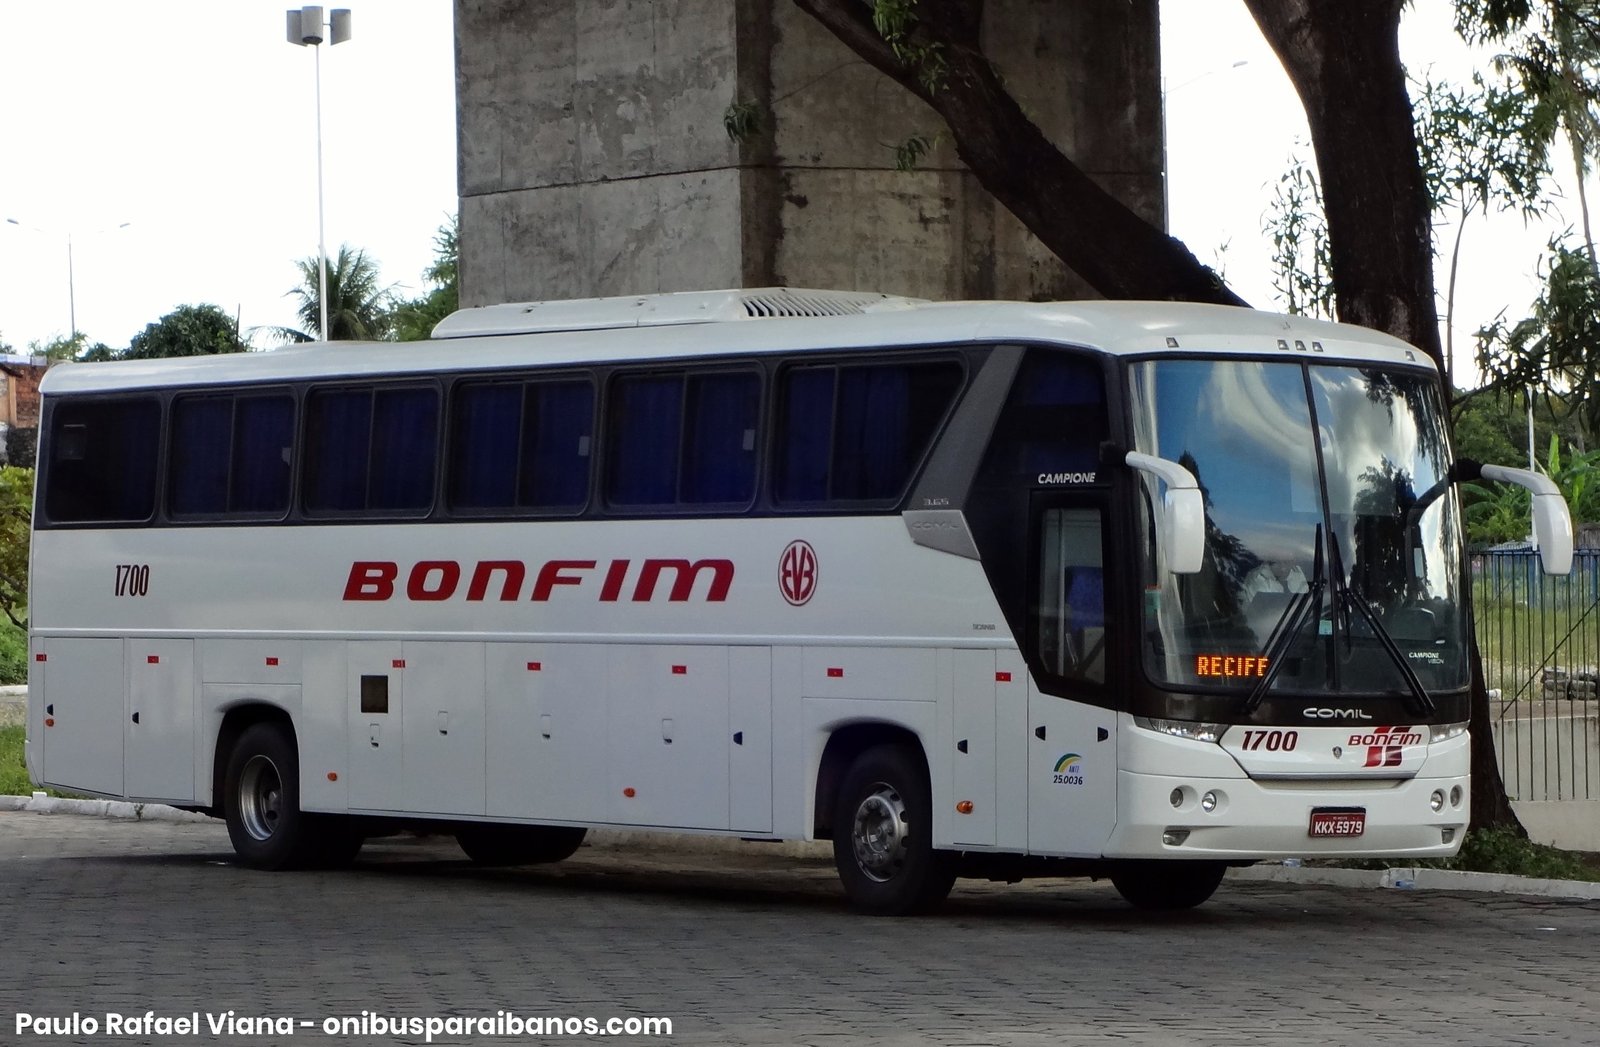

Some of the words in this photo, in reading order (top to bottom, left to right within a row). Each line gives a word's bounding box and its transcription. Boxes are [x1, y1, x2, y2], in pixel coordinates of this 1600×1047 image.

[1037, 472, 1096, 484] CAMPIONE
[115, 564, 150, 597] 1700
[342, 559, 735, 602] BONFIM
[1302, 707, 1373, 719] COMIL
[1241, 730, 1299, 752] 1700
[1348, 733, 1422, 746] BONFIM
[1053, 774, 1083, 785] 25.0036
